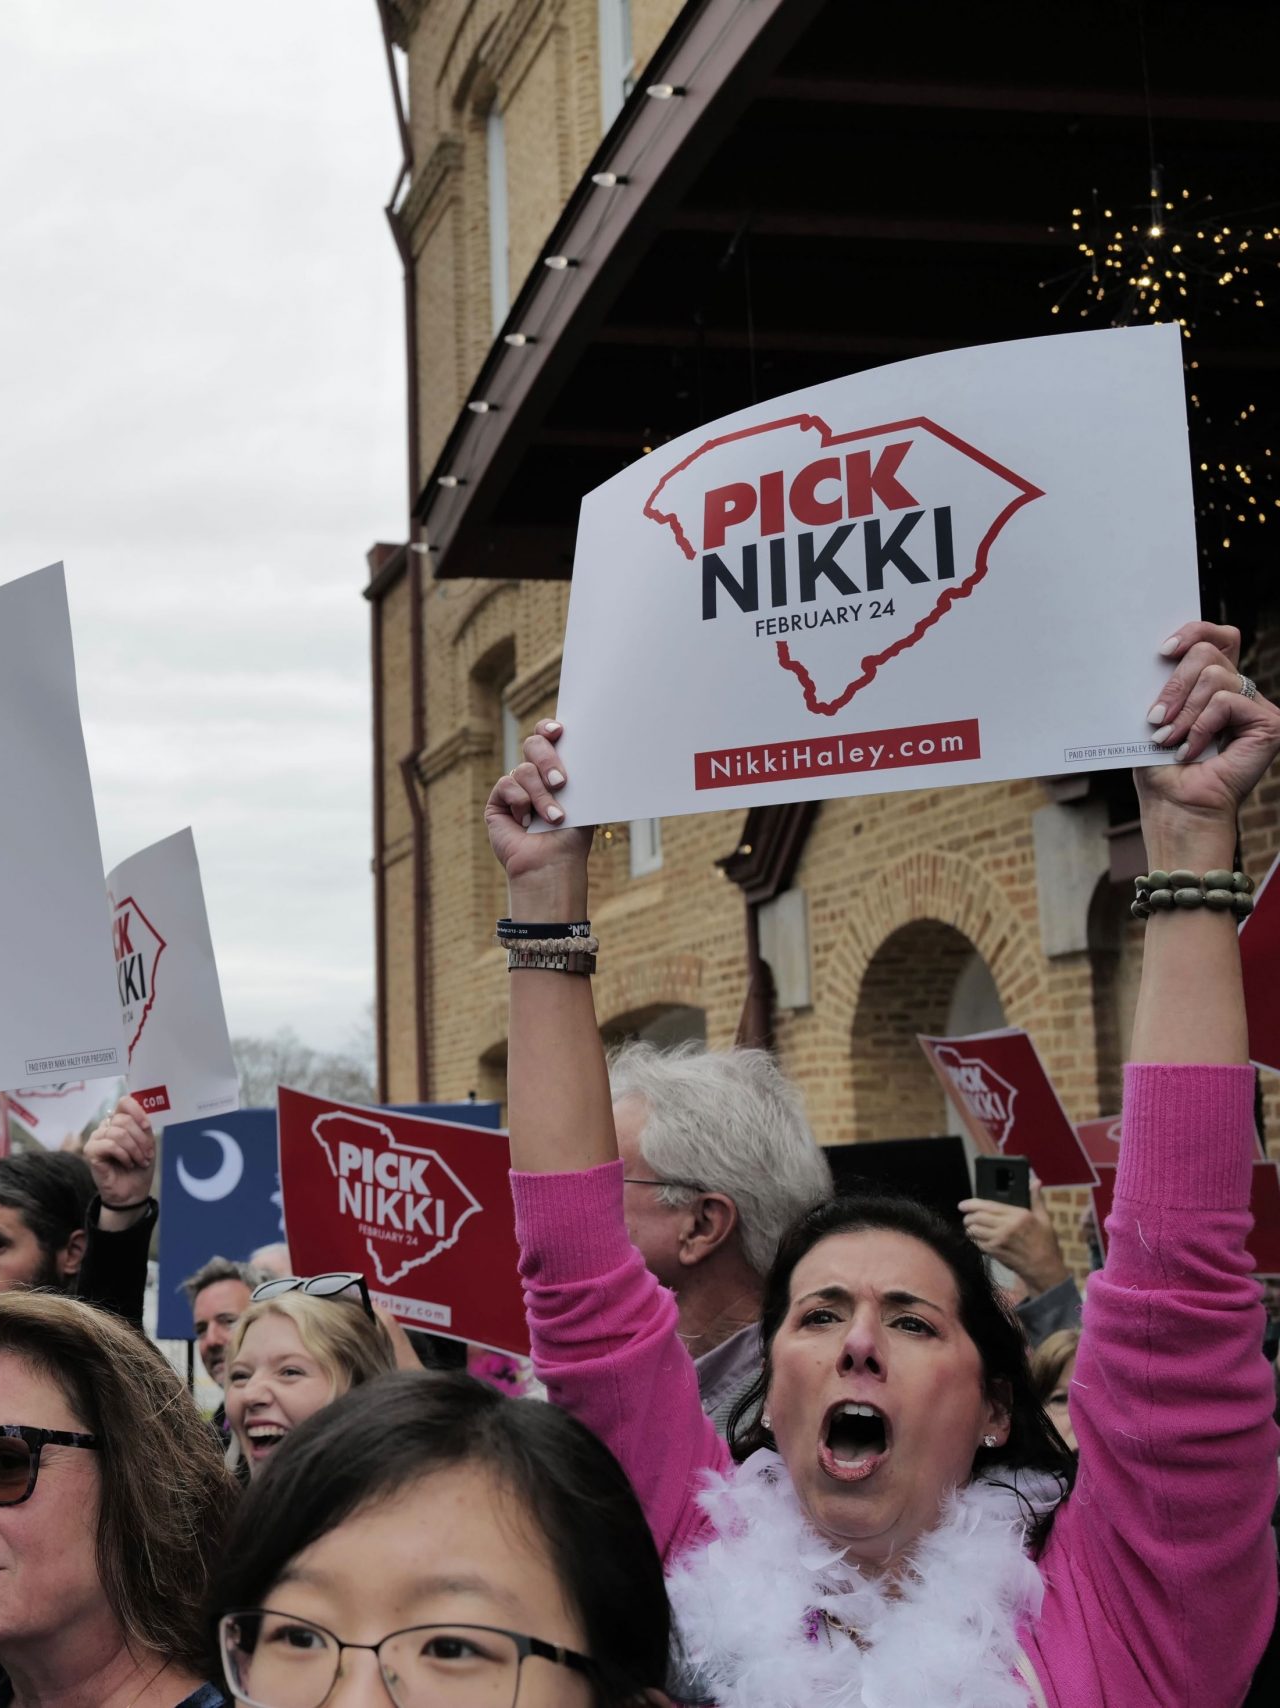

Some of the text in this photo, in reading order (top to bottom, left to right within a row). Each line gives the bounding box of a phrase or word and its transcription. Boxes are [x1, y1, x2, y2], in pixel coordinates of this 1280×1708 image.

[703, 440, 920, 550] PICK
[702, 505, 955, 621] NIKKI
[755, 598, 895, 637] FEBRUARY 24
[710, 735, 963, 779] NikkiHaley.com
[1085, 749, 1097, 757] FOR
[1127, 745, 1147, 753] HALEY
[112, 911, 134, 962] CK
[339, 1141, 431, 1196] PICK
[339, 1177, 445, 1238] NIKKI
[358, 1223, 418, 1246] FEBRUARY 24
[371, 1296, 445, 1320] Haley.com
